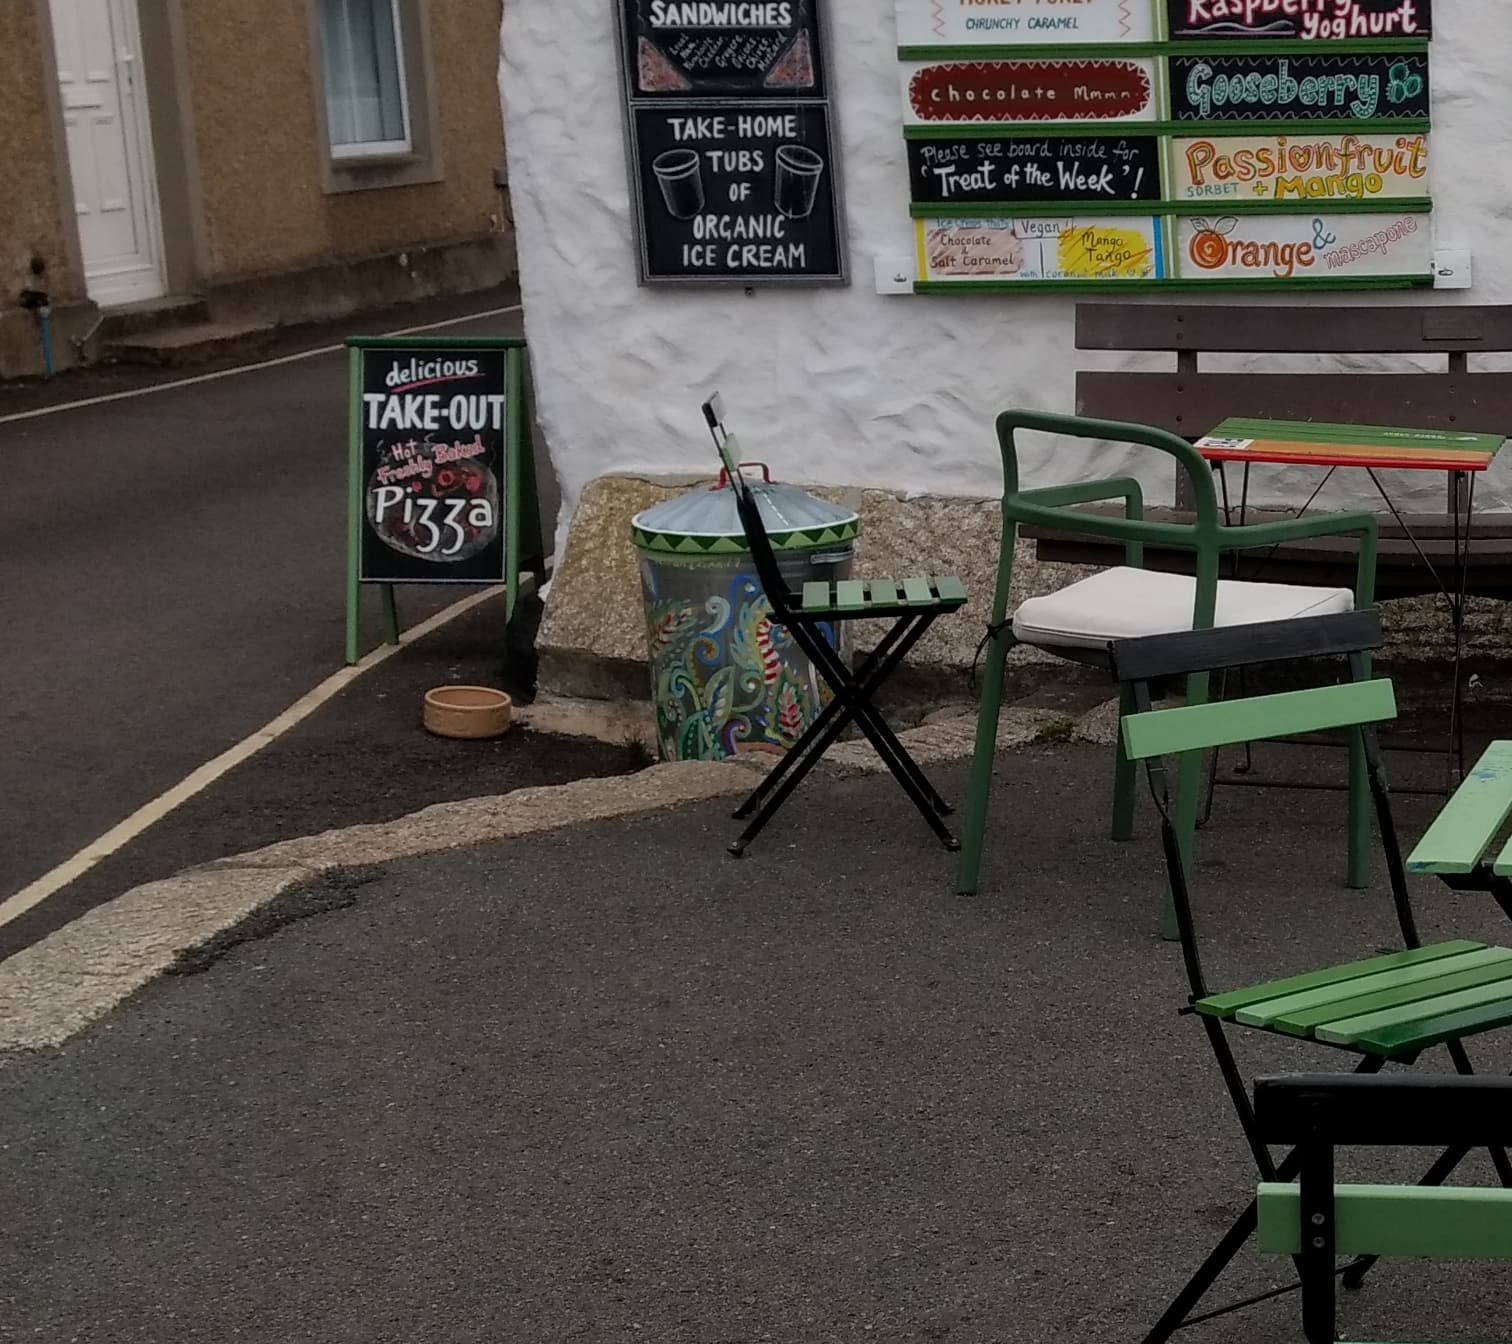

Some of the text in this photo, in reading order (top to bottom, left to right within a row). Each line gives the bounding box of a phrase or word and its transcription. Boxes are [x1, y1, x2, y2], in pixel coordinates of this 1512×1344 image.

[650, 0, 793, 26] SANDWICHES
[1027, 17, 1079, 30] CARAMEL
[931, 84, 1056, 101] chocolate
[1186, 59, 1379, 119] Gooseberry
[667, 115, 798, 140] TAKE-HOME
[705, 150, 764, 172] TUBS
[921, 139, 1139, 165] Please see board inside for
[1185, 135, 1428, 186] Passionfruit
[1003, 165, 1020, 188] of
[1024, 162, 1054, 186] the
[1187, 182, 1239, 197] SORBET
[1274, 172, 1383, 200] Mango
[729, 183, 751, 201] OF
[693, 214, 786, 242] ORGANIC
[940, 234, 992, 246] Chocolate
[1082, 231, 1124, 248] Mango
[682, 243, 806, 268] ICE CREAM
[1086, 248, 1131, 266] Tango
[1189, 229, 1316, 277] Orange
[1311, 217, 1336, 251] &
[930, 253, 1015, 269] Salt Caramel
[386, 358, 478, 387] delicious
[363, 393, 505, 431] TAKE-OUT
[391, 439, 417, 461] Hot
[372, 485, 493, 555] Pizza
